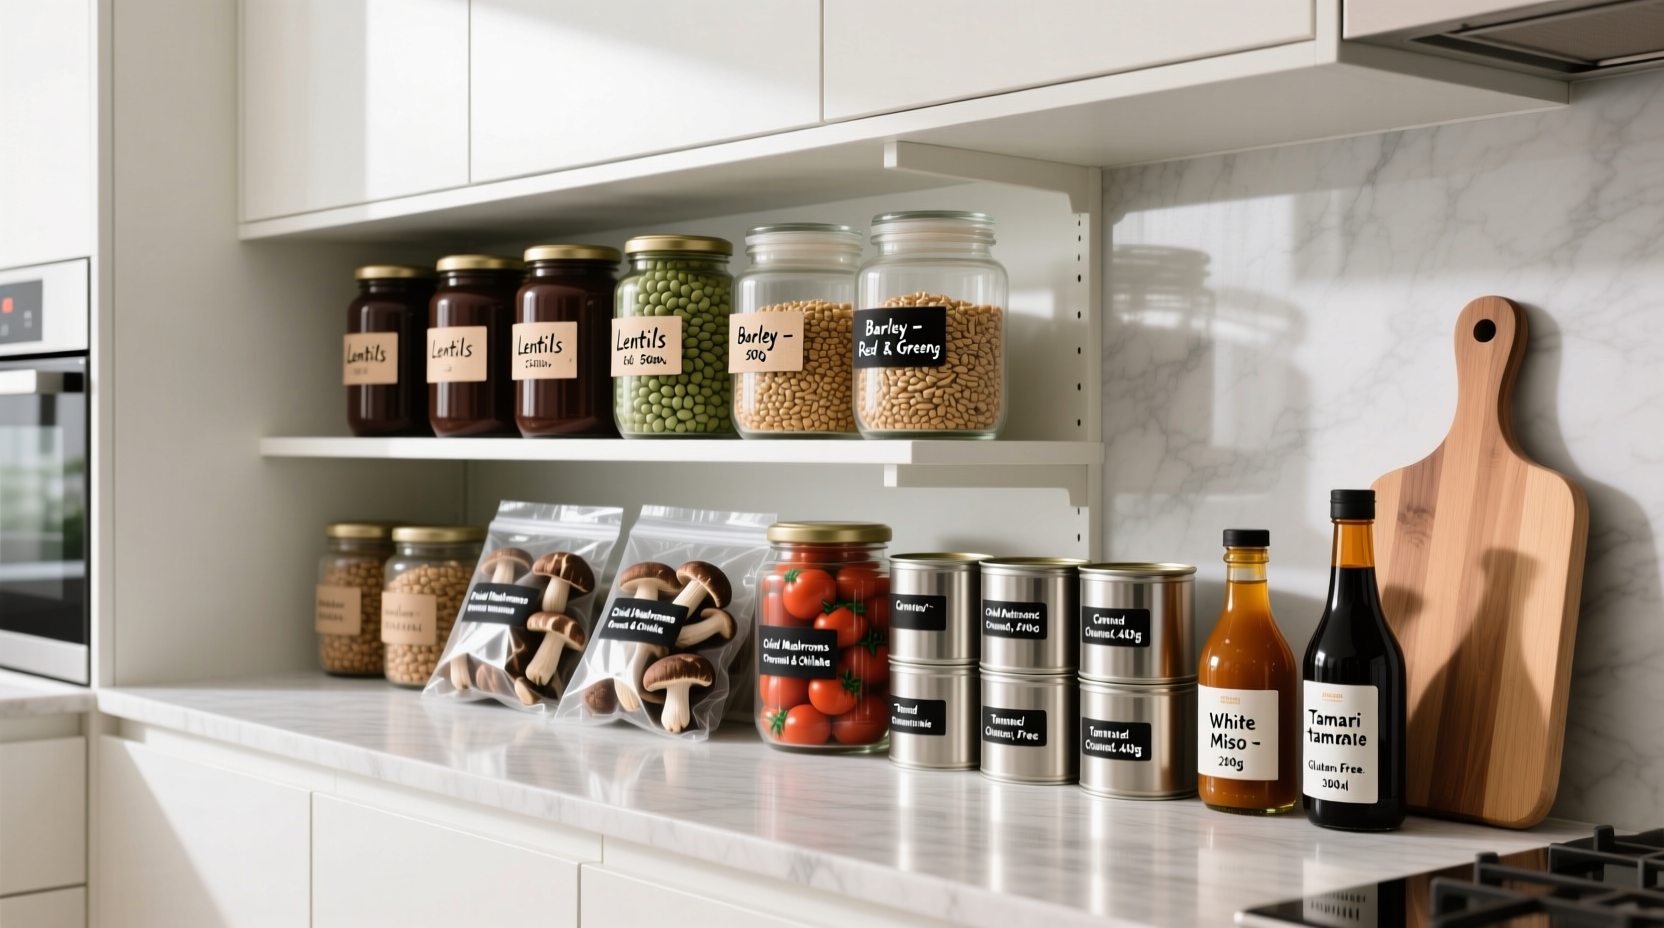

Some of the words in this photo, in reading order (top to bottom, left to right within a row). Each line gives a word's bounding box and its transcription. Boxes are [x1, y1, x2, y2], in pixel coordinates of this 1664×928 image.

[616, 327, 667, 352] Lentils
[865, 318, 908, 340] Barley
[346, 344, 387, 364] Lentils
[431, 337, 474, 360] Lentils
[518, 332, 564, 356] Lentils
[1209, 712, 1256, 731] White
[1308, 708, 1362, 728] Tamari
[1210, 732, 1247, 751] Miso
